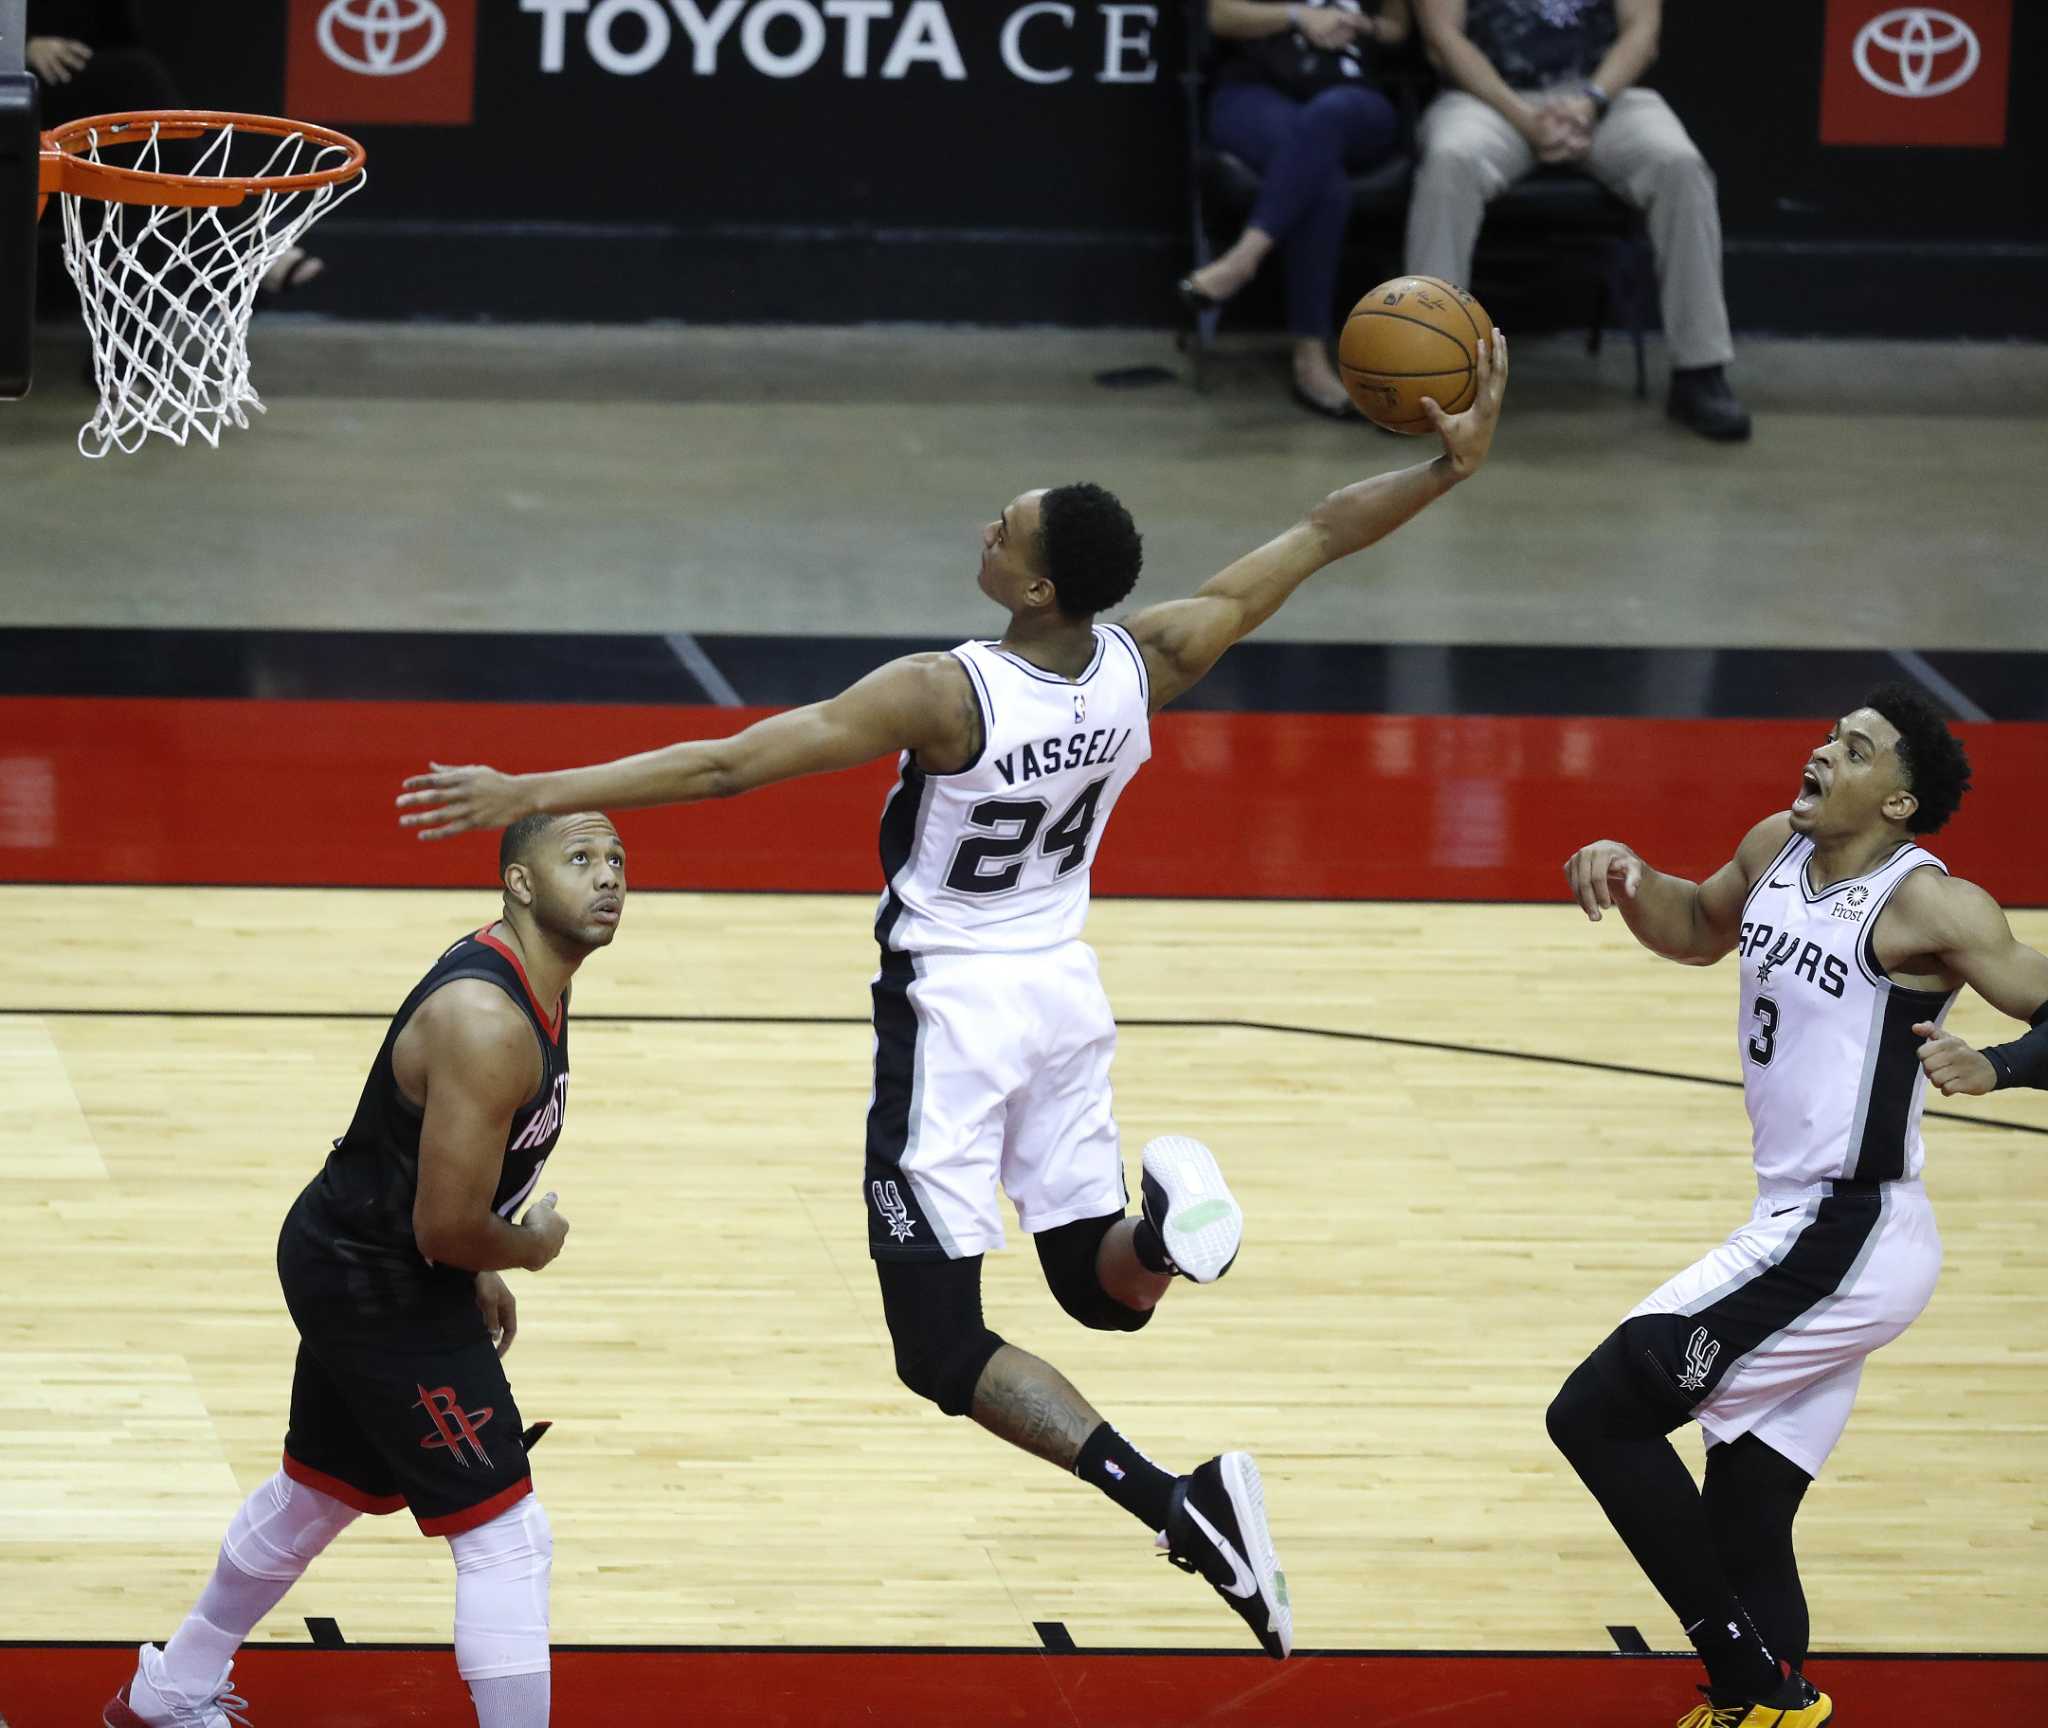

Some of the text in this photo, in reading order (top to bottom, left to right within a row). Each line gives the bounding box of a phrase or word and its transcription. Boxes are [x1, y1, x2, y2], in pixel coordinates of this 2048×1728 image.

[521, 0, 968, 80] TOYOTA
[993, 727, 1132, 786] VASSELL
[938, 769, 1113, 898] 24
[1831, 902, 1864, 922] Frost
[1748, 995, 1781, 1069] 3
